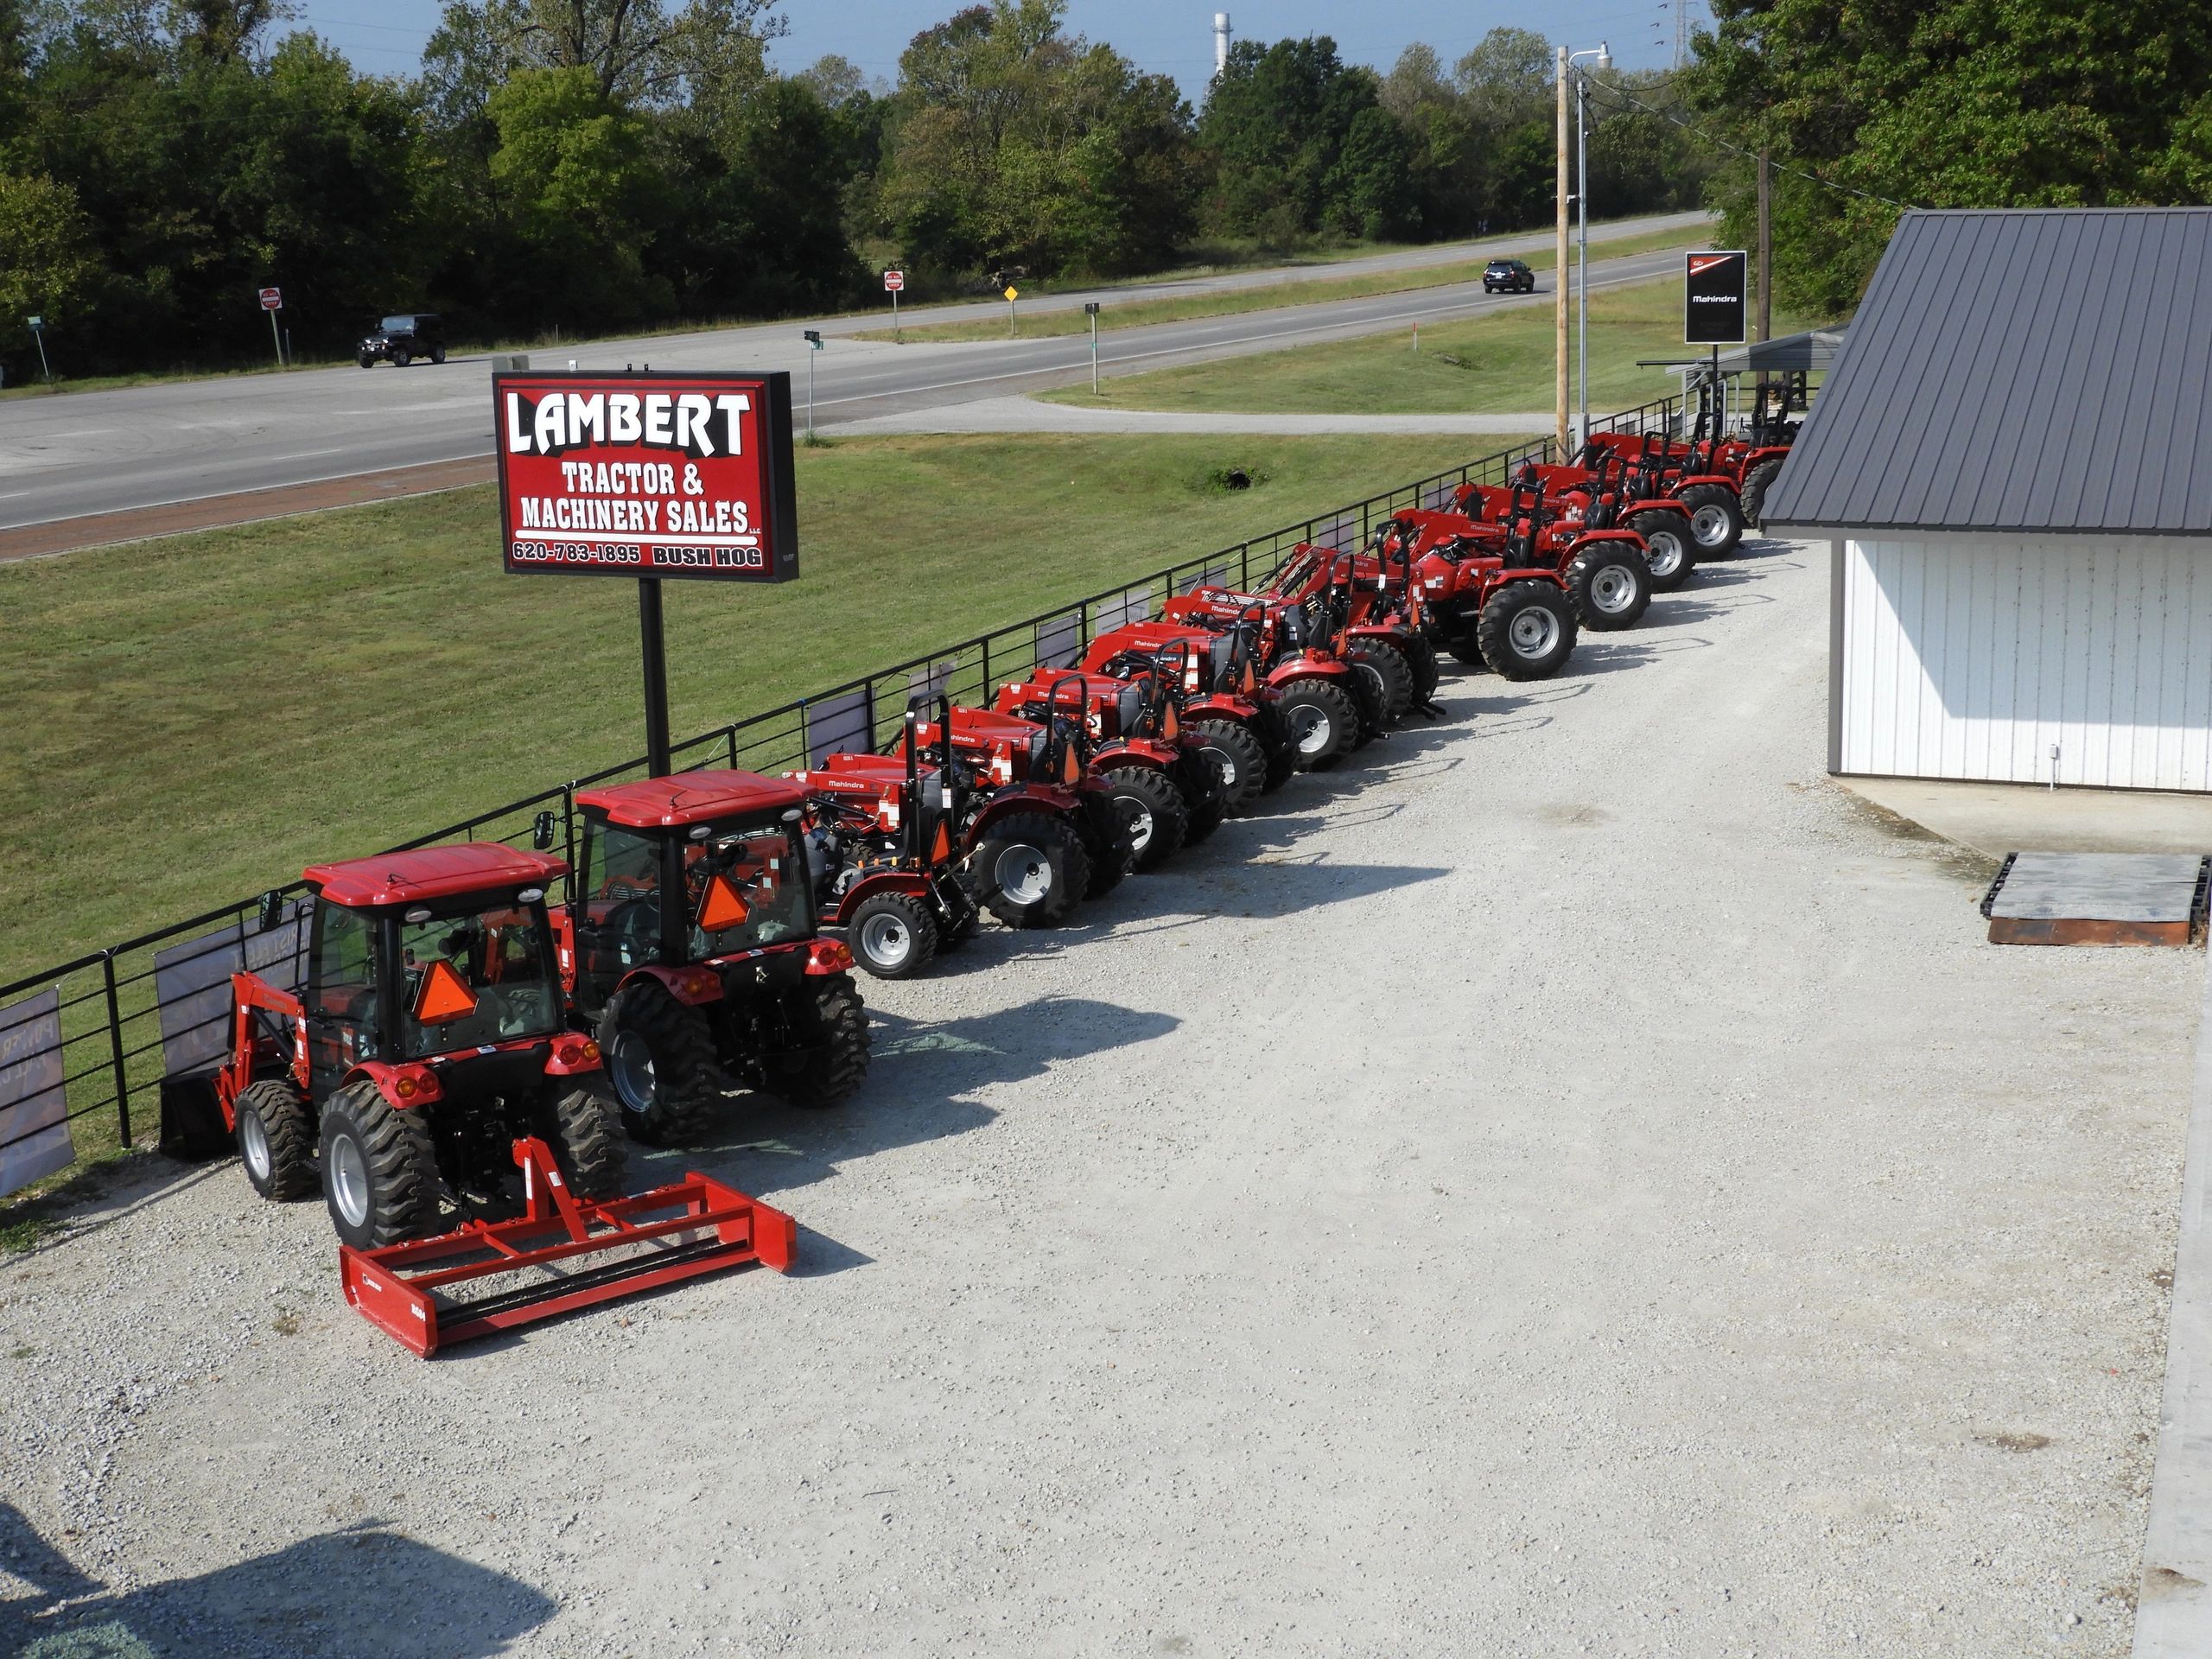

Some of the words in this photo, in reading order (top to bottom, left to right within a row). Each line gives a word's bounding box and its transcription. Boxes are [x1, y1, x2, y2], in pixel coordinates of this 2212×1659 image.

[506, 392, 751, 457] LAMBERT
[562, 461, 676, 495] TRACTOR
[683, 462, 704, 495] &
[520, 497, 659, 531] MACHINERY
[667, 499, 748, 534] SALES
[512, 542, 641, 563] 620-783-1895
[652, 546, 712, 566] BUSH
[715, 548, 763, 566] HOG
[829, 780, 865, 789] Mahindra
